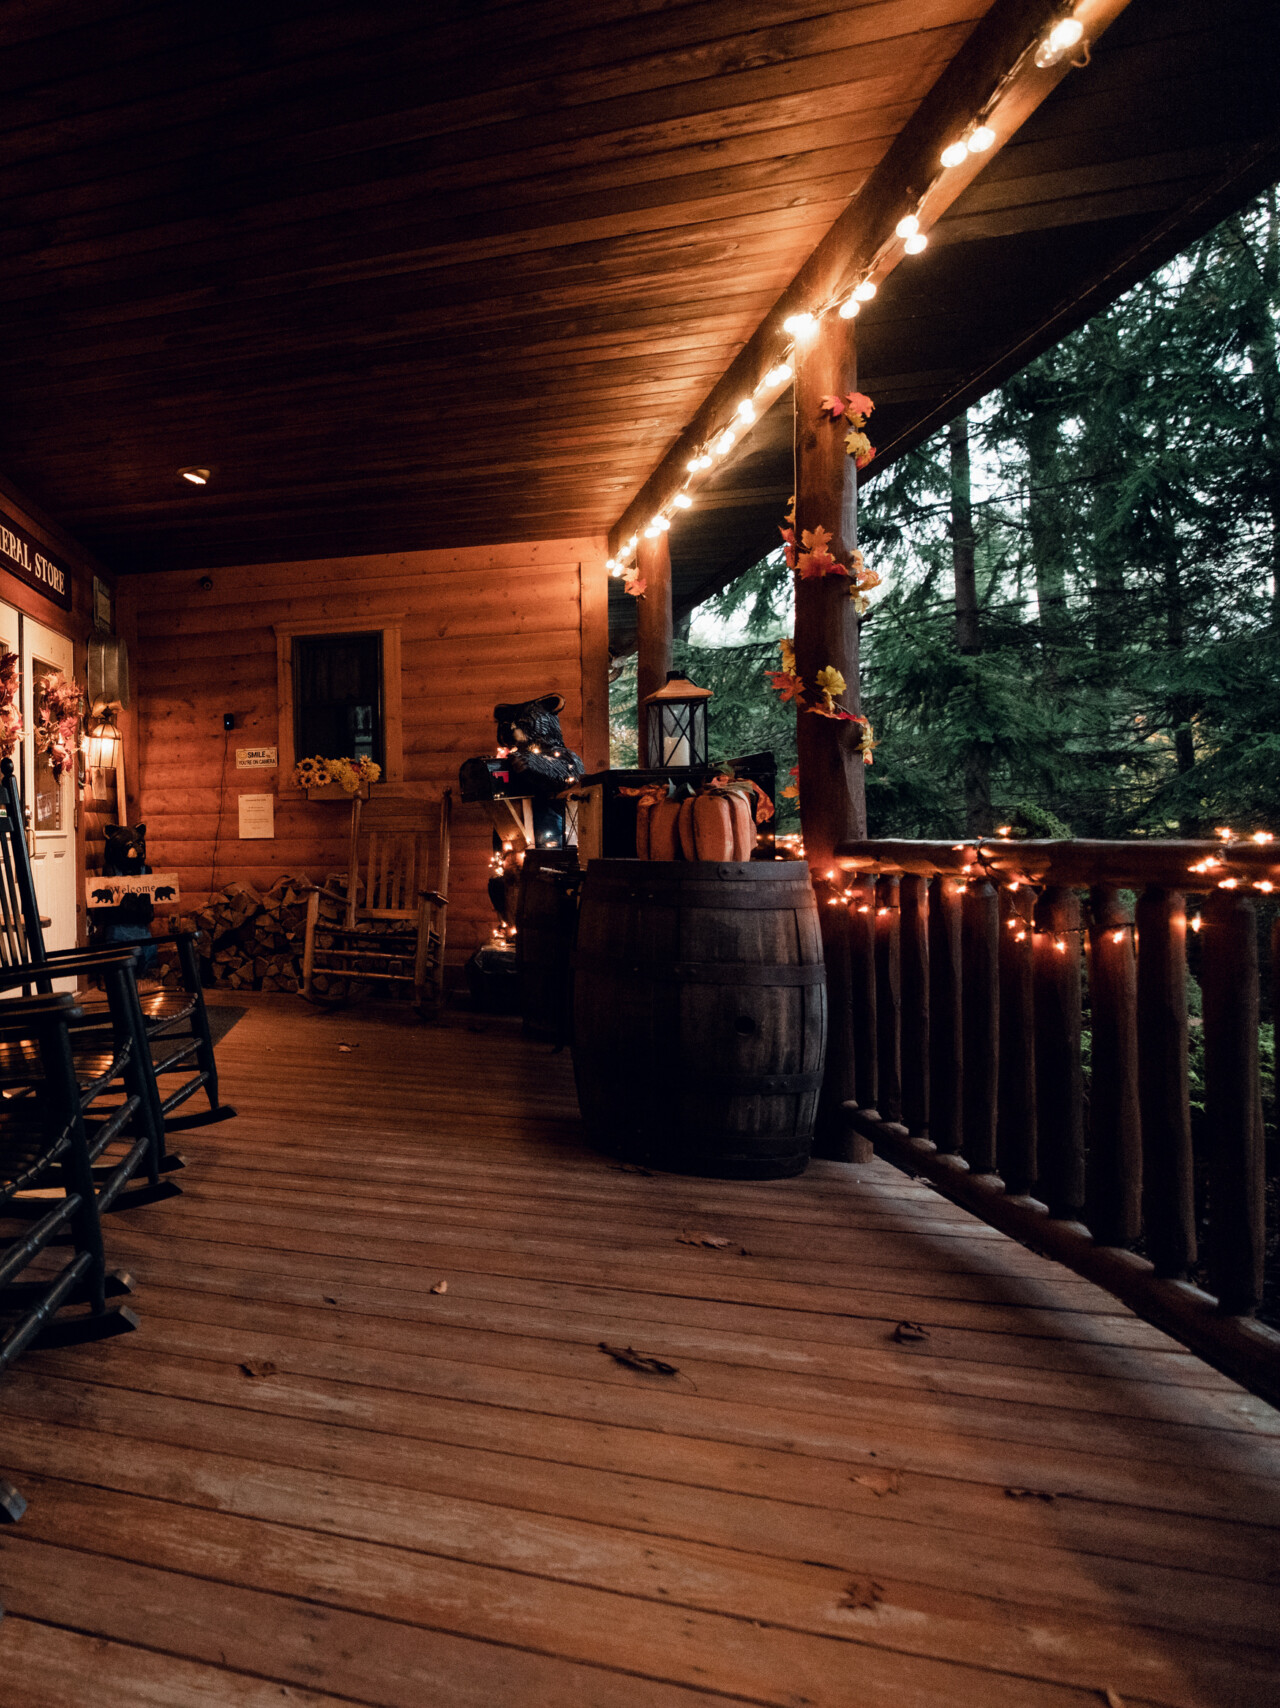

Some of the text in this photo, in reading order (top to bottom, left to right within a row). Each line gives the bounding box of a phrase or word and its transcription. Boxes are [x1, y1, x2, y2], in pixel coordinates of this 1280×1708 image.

[34, 553, 65, 595] STORE
[247, 750, 266, 759] SMILE
[110, 884, 156, 895] Welcome
